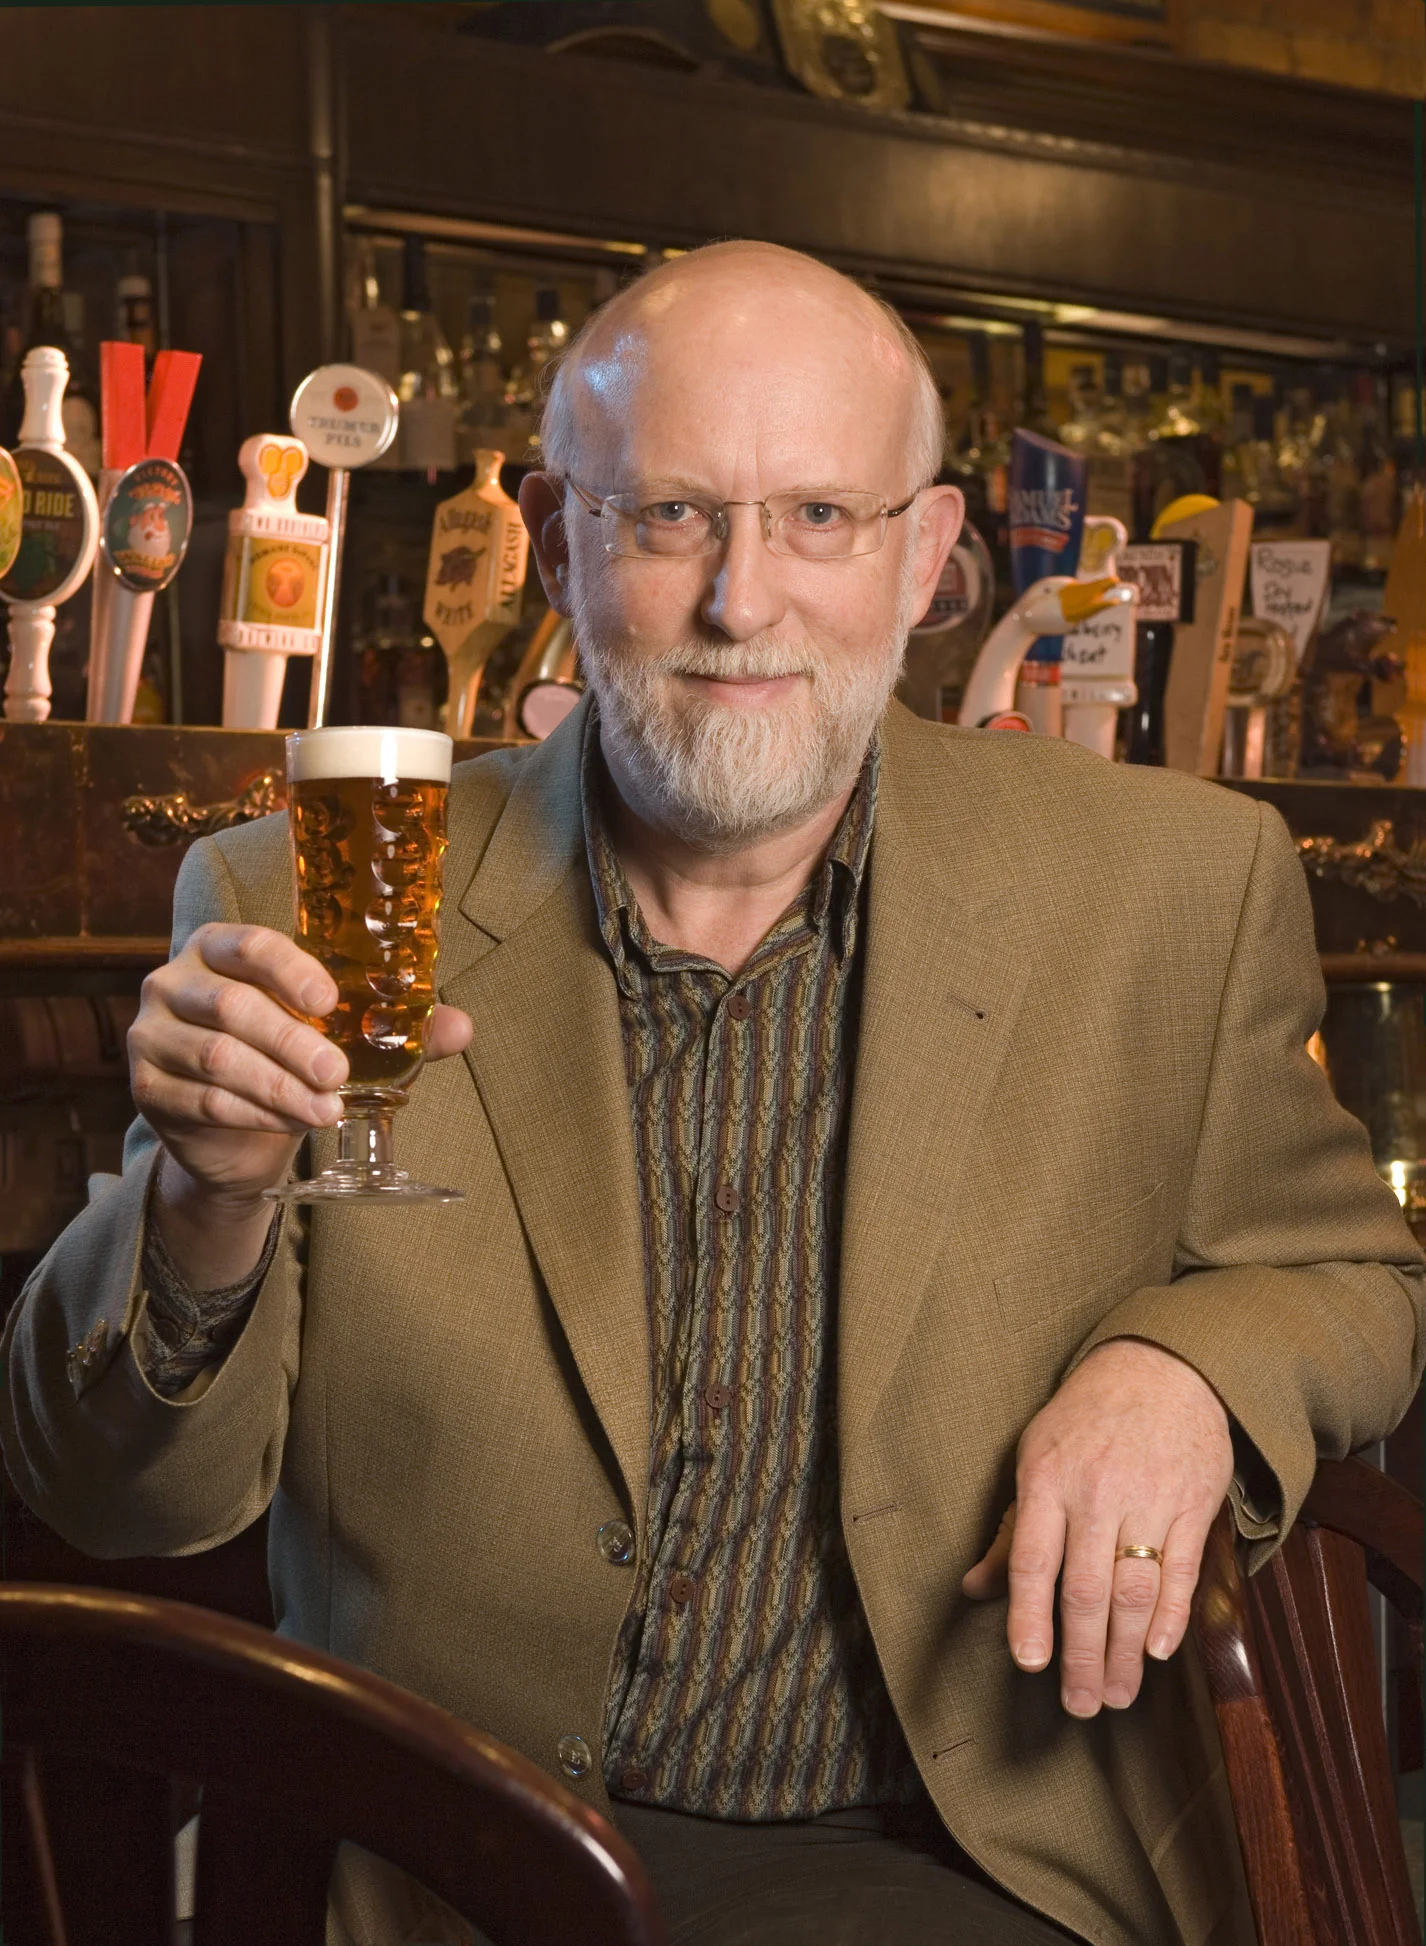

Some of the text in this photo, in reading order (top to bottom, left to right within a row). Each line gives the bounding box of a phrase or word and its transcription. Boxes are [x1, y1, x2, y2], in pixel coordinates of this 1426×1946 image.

[307, 415, 379, 433] TRUMER
[326, 434, 362, 447] PILS
[33, 490, 77, 518] RIDE
[499, 522, 522, 609] ALLAGASH
